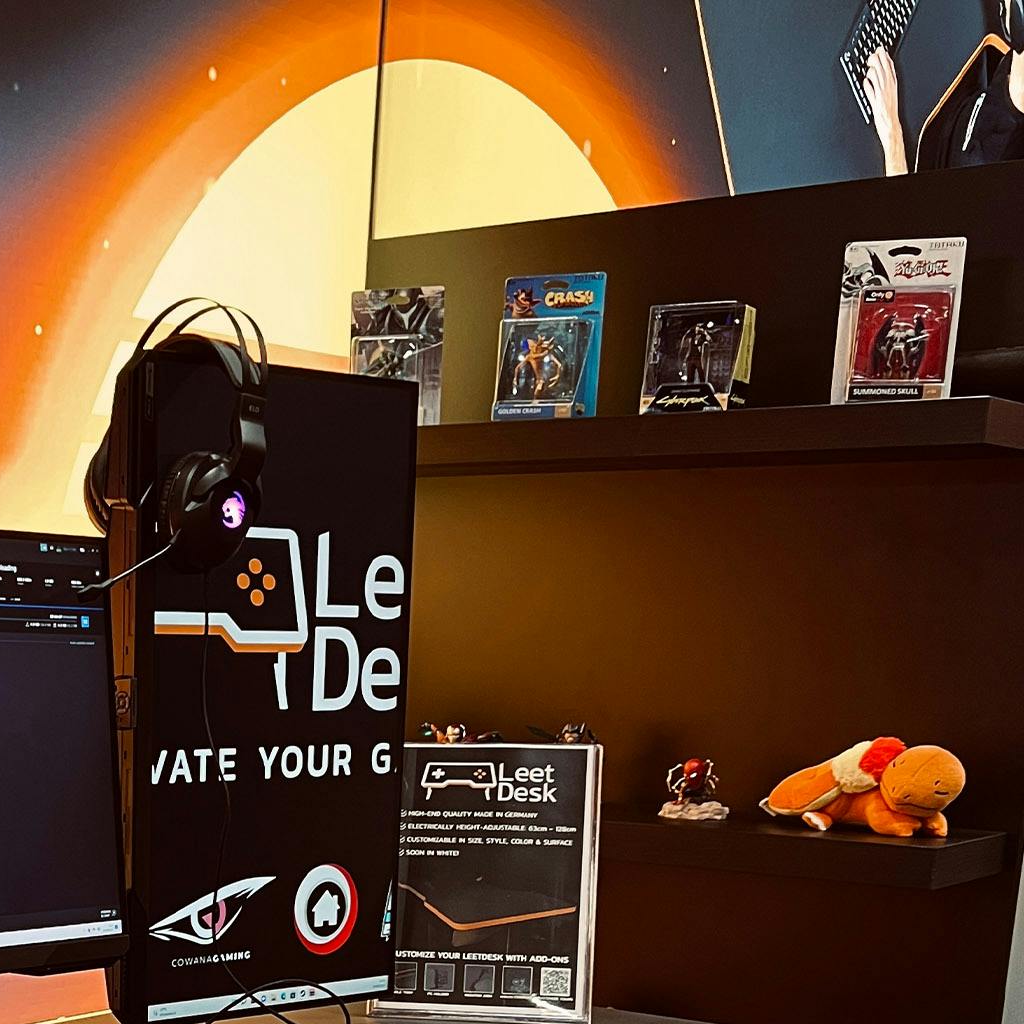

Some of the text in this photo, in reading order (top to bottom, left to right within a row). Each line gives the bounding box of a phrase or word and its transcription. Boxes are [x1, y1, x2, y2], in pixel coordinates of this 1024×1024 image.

[544, 290, 594, 306] CRASH
[316, 532, 405, 620] Le
[312, 626, 401, 712] De
[258, 744, 352, 780] YOUR
[499, 763, 555, 783] Leet
[497, 783, 557, 803] Desk
[442, 811, 472, 819] QUALITY
[407, 823, 454, 831] ELECTRICALLY
[406, 836, 457, 845] CUSTOMIZABLE
[510, 838, 534, 846] COLOR
[405, 849, 425, 857] SOON
[438, 952, 461, 960] YOUR
[462, 953, 504, 962] LEETDESK
[505, 954, 527, 962] WITH
[529, 956, 570, 964] ADD-ONS
